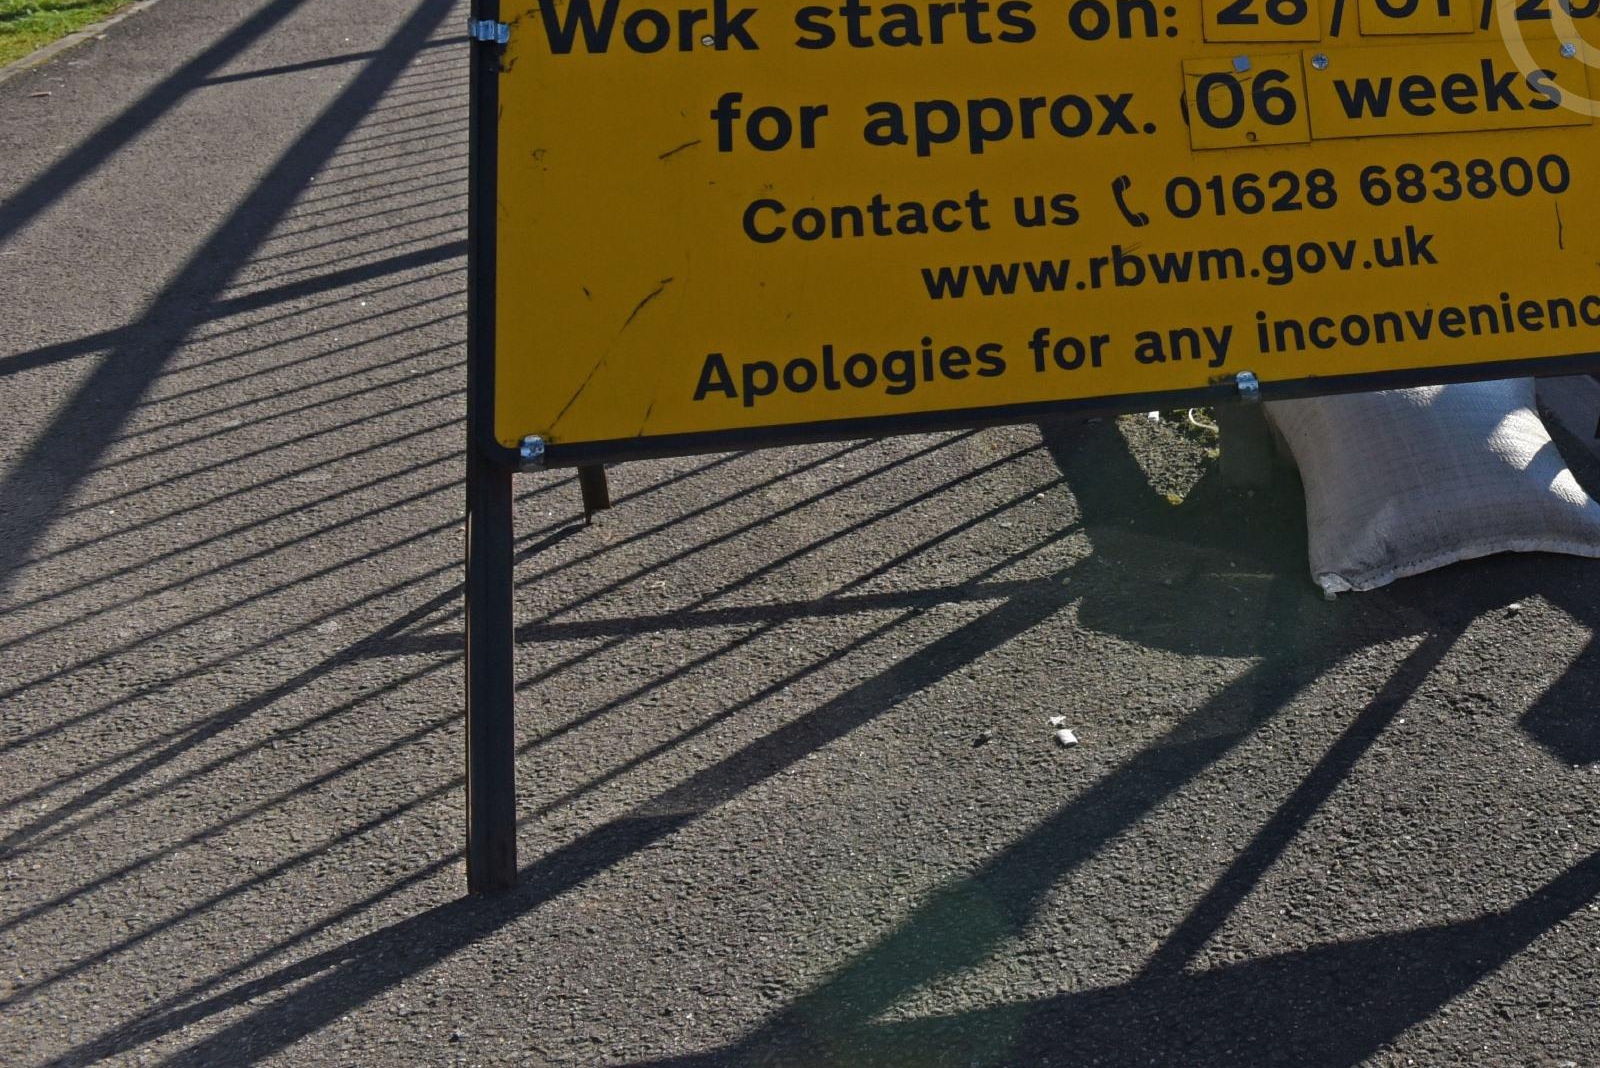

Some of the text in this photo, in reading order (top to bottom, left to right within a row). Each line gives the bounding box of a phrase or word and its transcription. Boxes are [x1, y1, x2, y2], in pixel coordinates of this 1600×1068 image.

[710, 59, 1561, 157] for approx. 06 weeks
[743, 154, 1570, 243] Contact us 01628 683800
[921, 226, 1438, 300] www.rbwm.gov.uk
[693, 337, 1006, 407] Apologies
[1028, 328, 1110, 372] for
[1135, 325, 1232, 368] any
